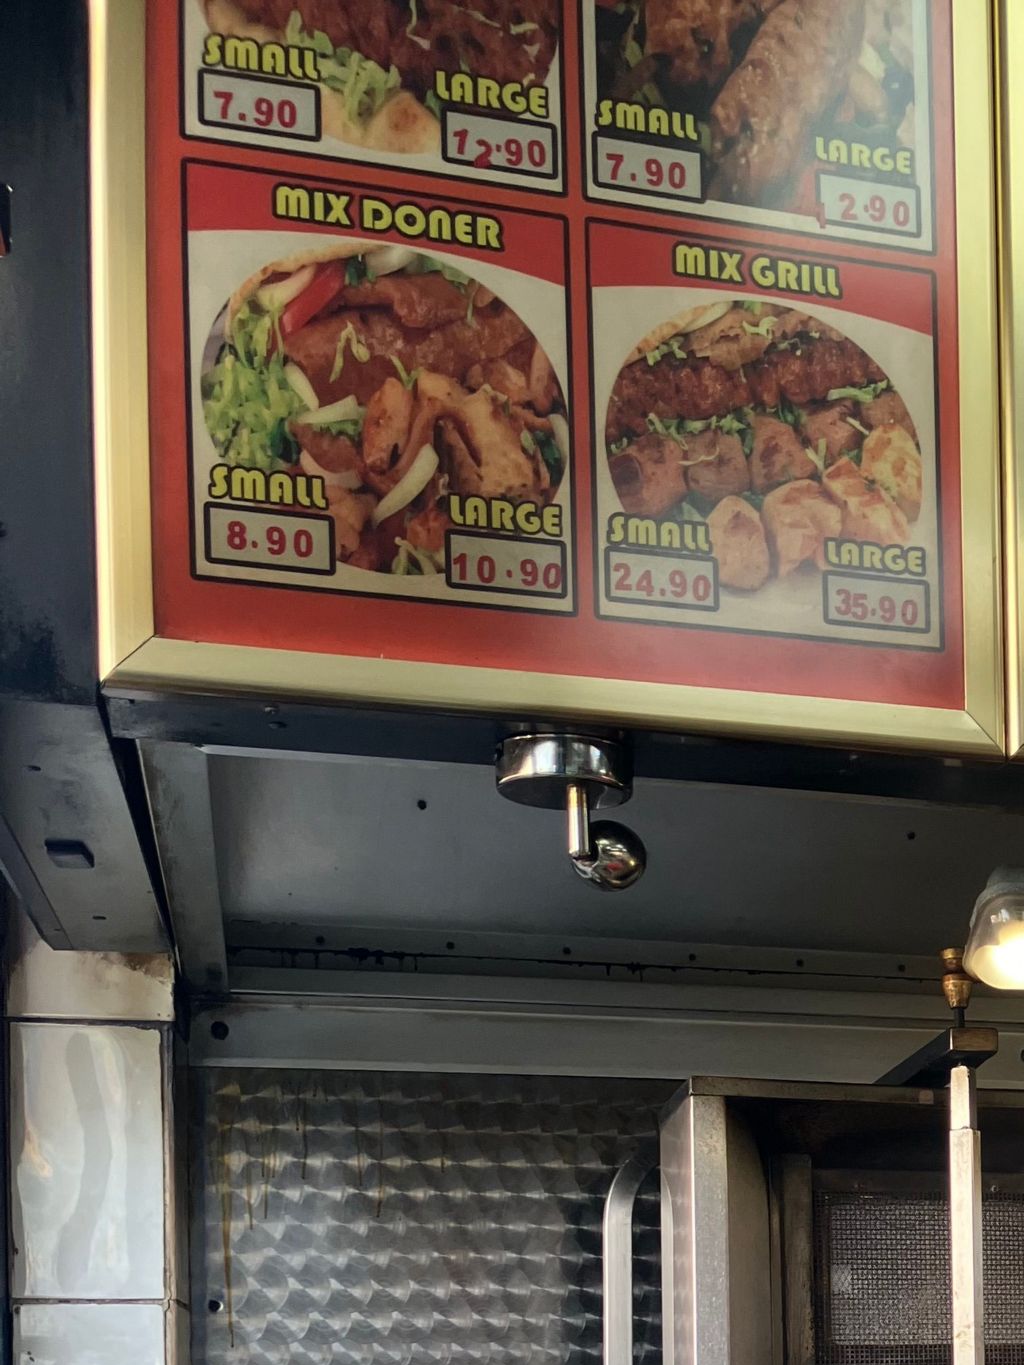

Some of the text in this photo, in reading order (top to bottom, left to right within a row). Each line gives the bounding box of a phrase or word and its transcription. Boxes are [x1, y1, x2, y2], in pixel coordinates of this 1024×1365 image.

[202, 34, 320, 80] SMALL
[213, 91, 297, 129] 7.90
[434, 70, 549, 117] LARGE
[596, 99, 699, 142] SMALL
[605, 153, 687, 190] 7.90
[815, 136, 912, 174] LARGE
[273, 185, 504, 250] MIX DONER
[673, 244, 842, 298] MIX GRILL
[209, 464, 327, 509] SMALL
[448, 494, 563, 536] LARGE
[608, 513, 711, 553] SMALL
[226, 520, 314, 558] 8.90
[824, 538, 926, 576] LARGE
[453, 553, 562, 590] 10.90
[612, 563, 712, 602] 24.90
[834, 588, 919, 626] 35.90
